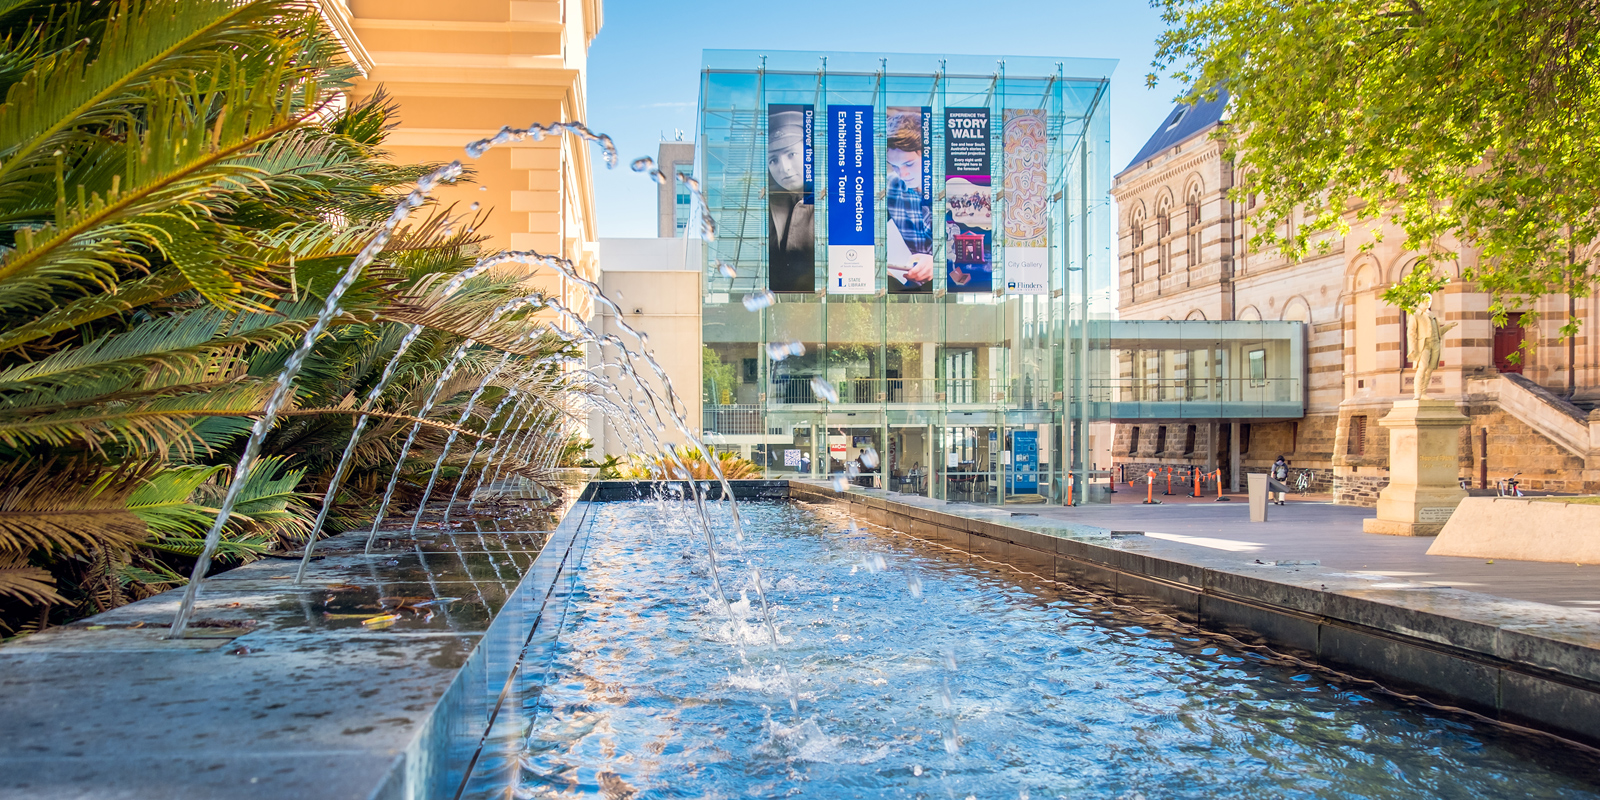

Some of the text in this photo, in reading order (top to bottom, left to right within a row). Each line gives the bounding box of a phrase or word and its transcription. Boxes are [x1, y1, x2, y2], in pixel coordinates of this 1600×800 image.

[922, 112, 930, 145] Prepare
[948, 118, 988, 128] STORY
[951, 128, 984, 138] WALL
[838, 111, 847, 203] Exhibitions Tours
[804, 163, 813, 182] past
[854, 111, 865, 232] Information Collections
